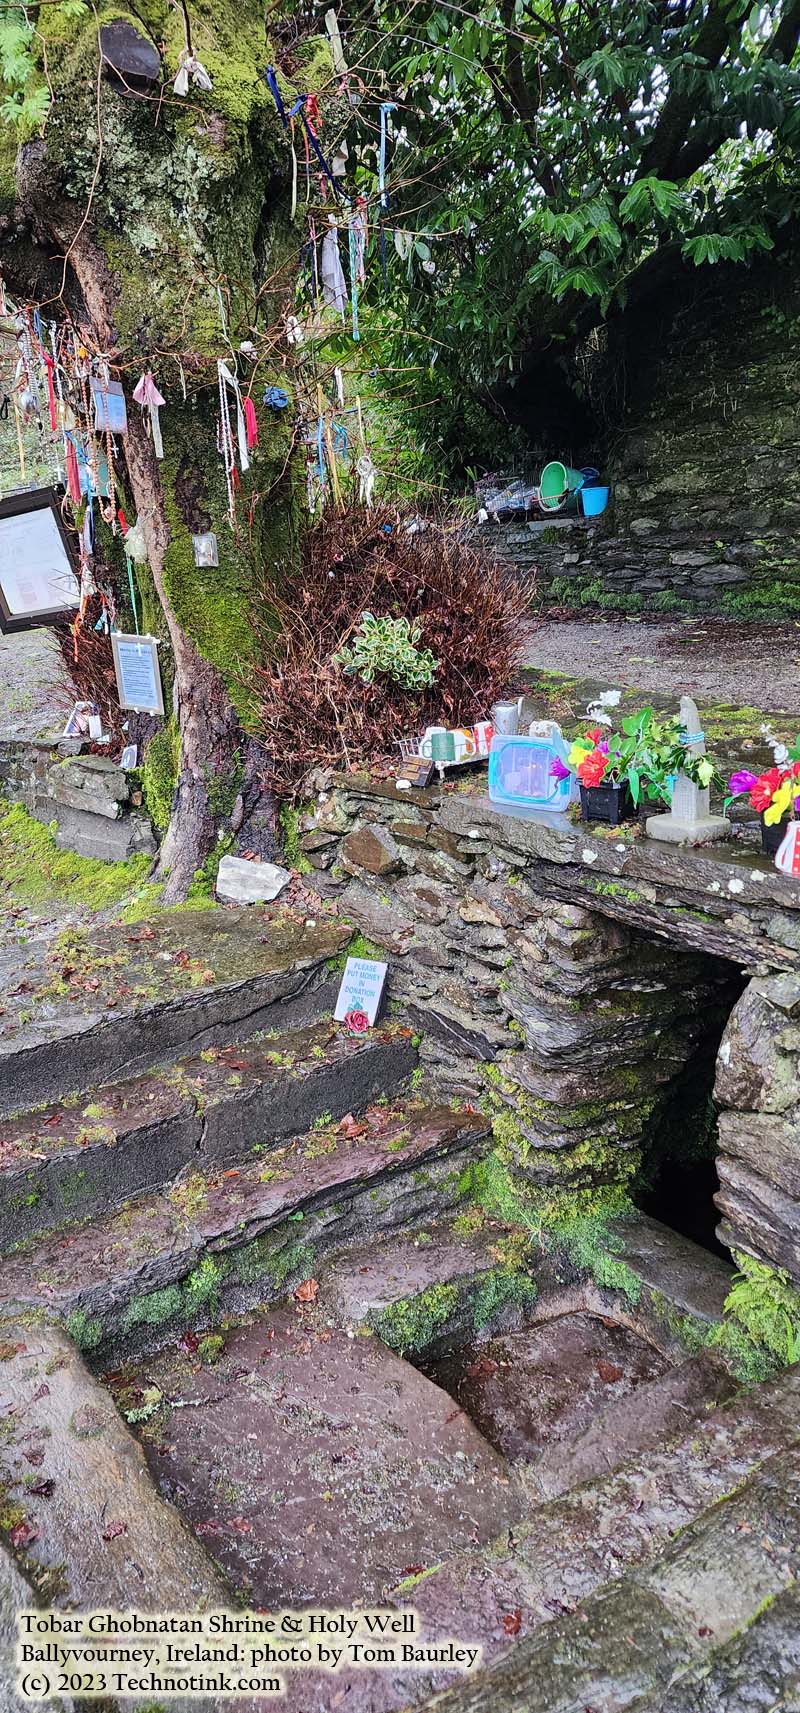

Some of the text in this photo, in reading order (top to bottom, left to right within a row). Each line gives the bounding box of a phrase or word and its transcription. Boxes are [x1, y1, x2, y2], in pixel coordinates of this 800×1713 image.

[353, 962, 377, 972] PLEASE
[360, 971, 380, 981] MONEY
[344, 986, 375, 997] DONATION
